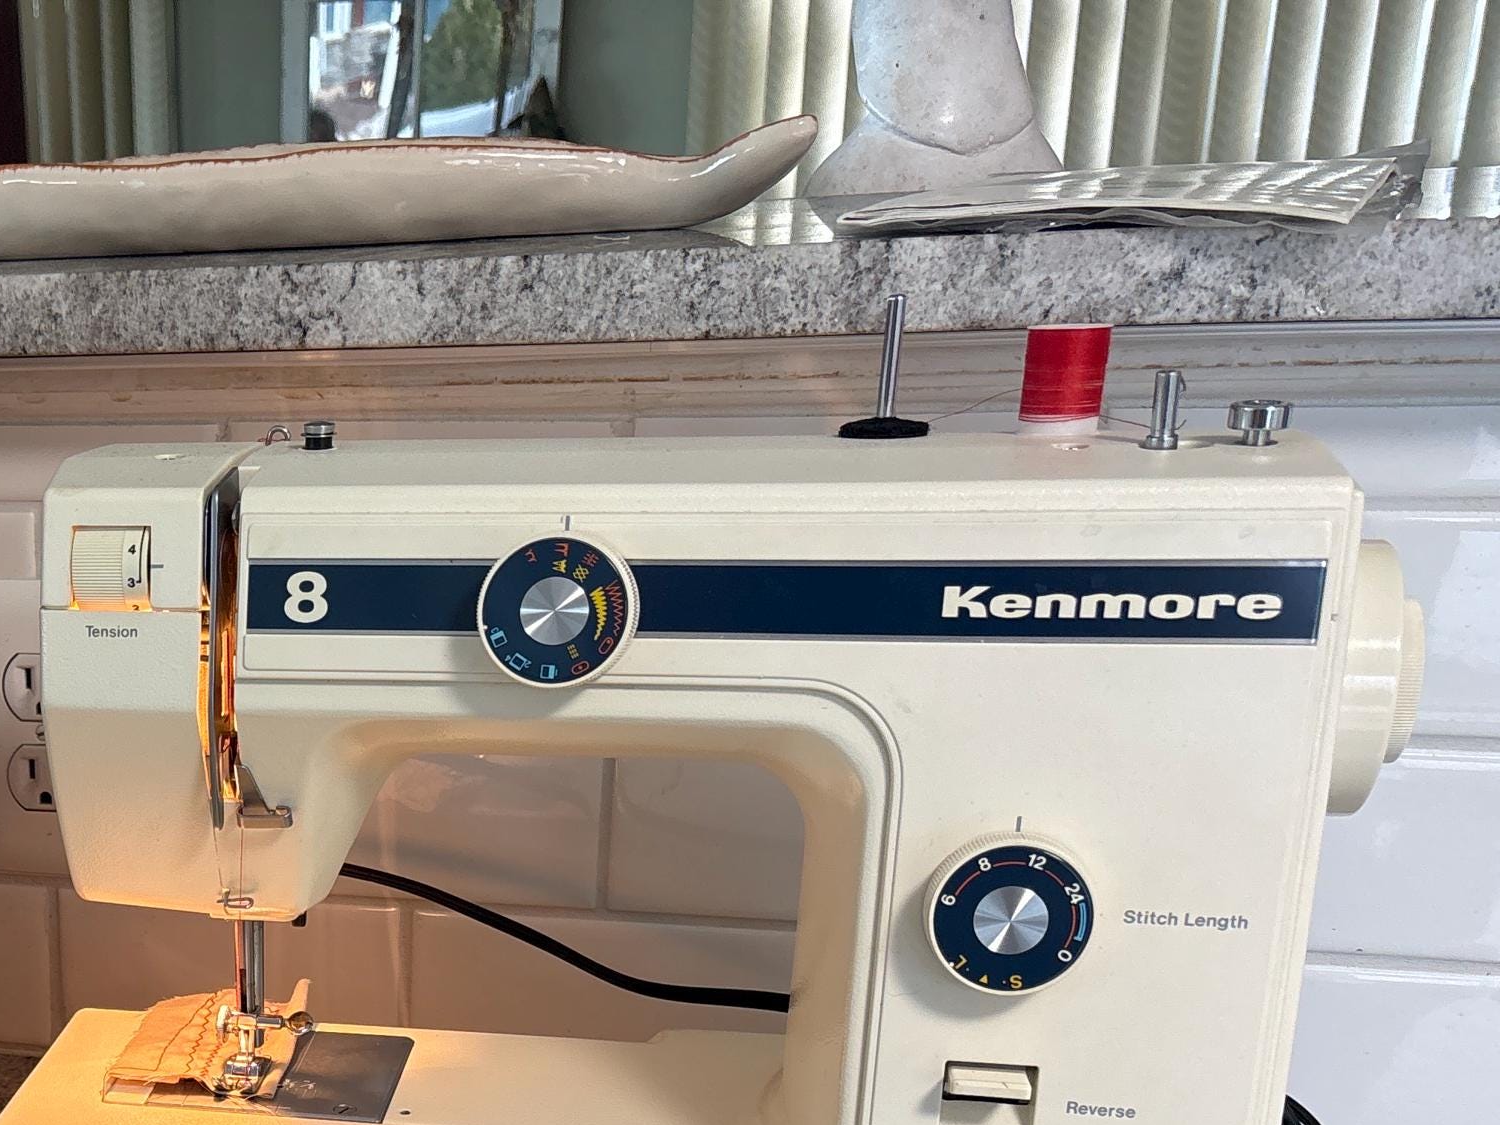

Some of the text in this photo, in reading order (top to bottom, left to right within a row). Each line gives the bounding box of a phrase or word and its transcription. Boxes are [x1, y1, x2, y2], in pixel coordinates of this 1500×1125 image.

[127, 544, 137, 555] 4
[127, 577, 136, 588] 3
[283, 570, 328, 624] 8
[940, 584, 1283, 621] Kenmore
[85, 625, 138, 638] Tension
[941, 894, 956, 906] 6
[977, 857, 992, 872] 8
[1027, 854, 1047, 870] 12
[1063, 883, 1085, 905] 24
[1123, 909, 1249, 931] Stitch Length
[1009, 974, 1023, 989] S
[1065, 1100, 1136, 1119] Reverse
